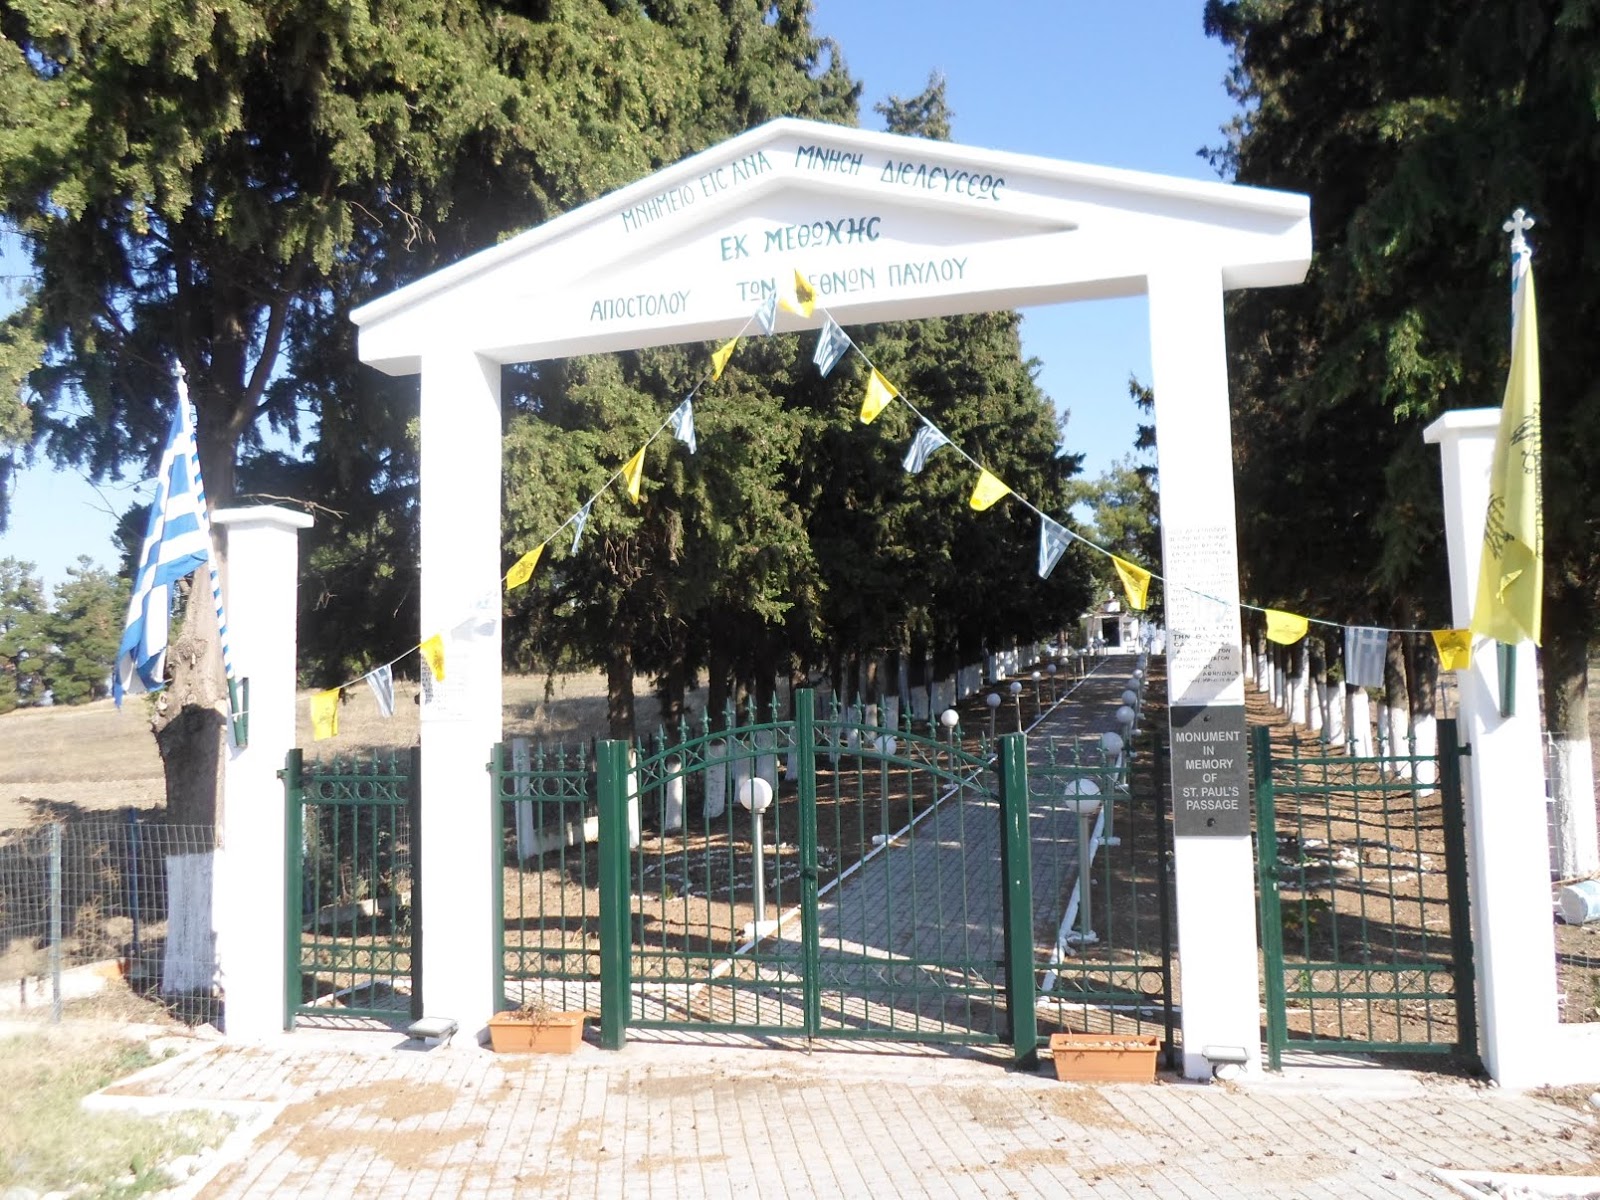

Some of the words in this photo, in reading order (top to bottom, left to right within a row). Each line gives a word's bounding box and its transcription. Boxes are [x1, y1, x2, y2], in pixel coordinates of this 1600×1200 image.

[621, 185, 695, 233] ΜΝΗΜΕΙΟ
[732, 151, 773, 186] ΑΝΑ
[720, 233, 750, 262] ΕΚ
[888, 257, 969, 288] ΠΑΥΛΟΥ
[1175, 731, 1241, 743] MONUMENT
[1203, 745, 1215, 756] IN
[1185, 759, 1234, 770] MEMORY
[1202, 773, 1218, 783] OF
[1182, 787, 1199, 798] ST.
[1201, 787, 1240, 798] PAUL'S
[1186, 799, 1239, 811] PASSAGE
